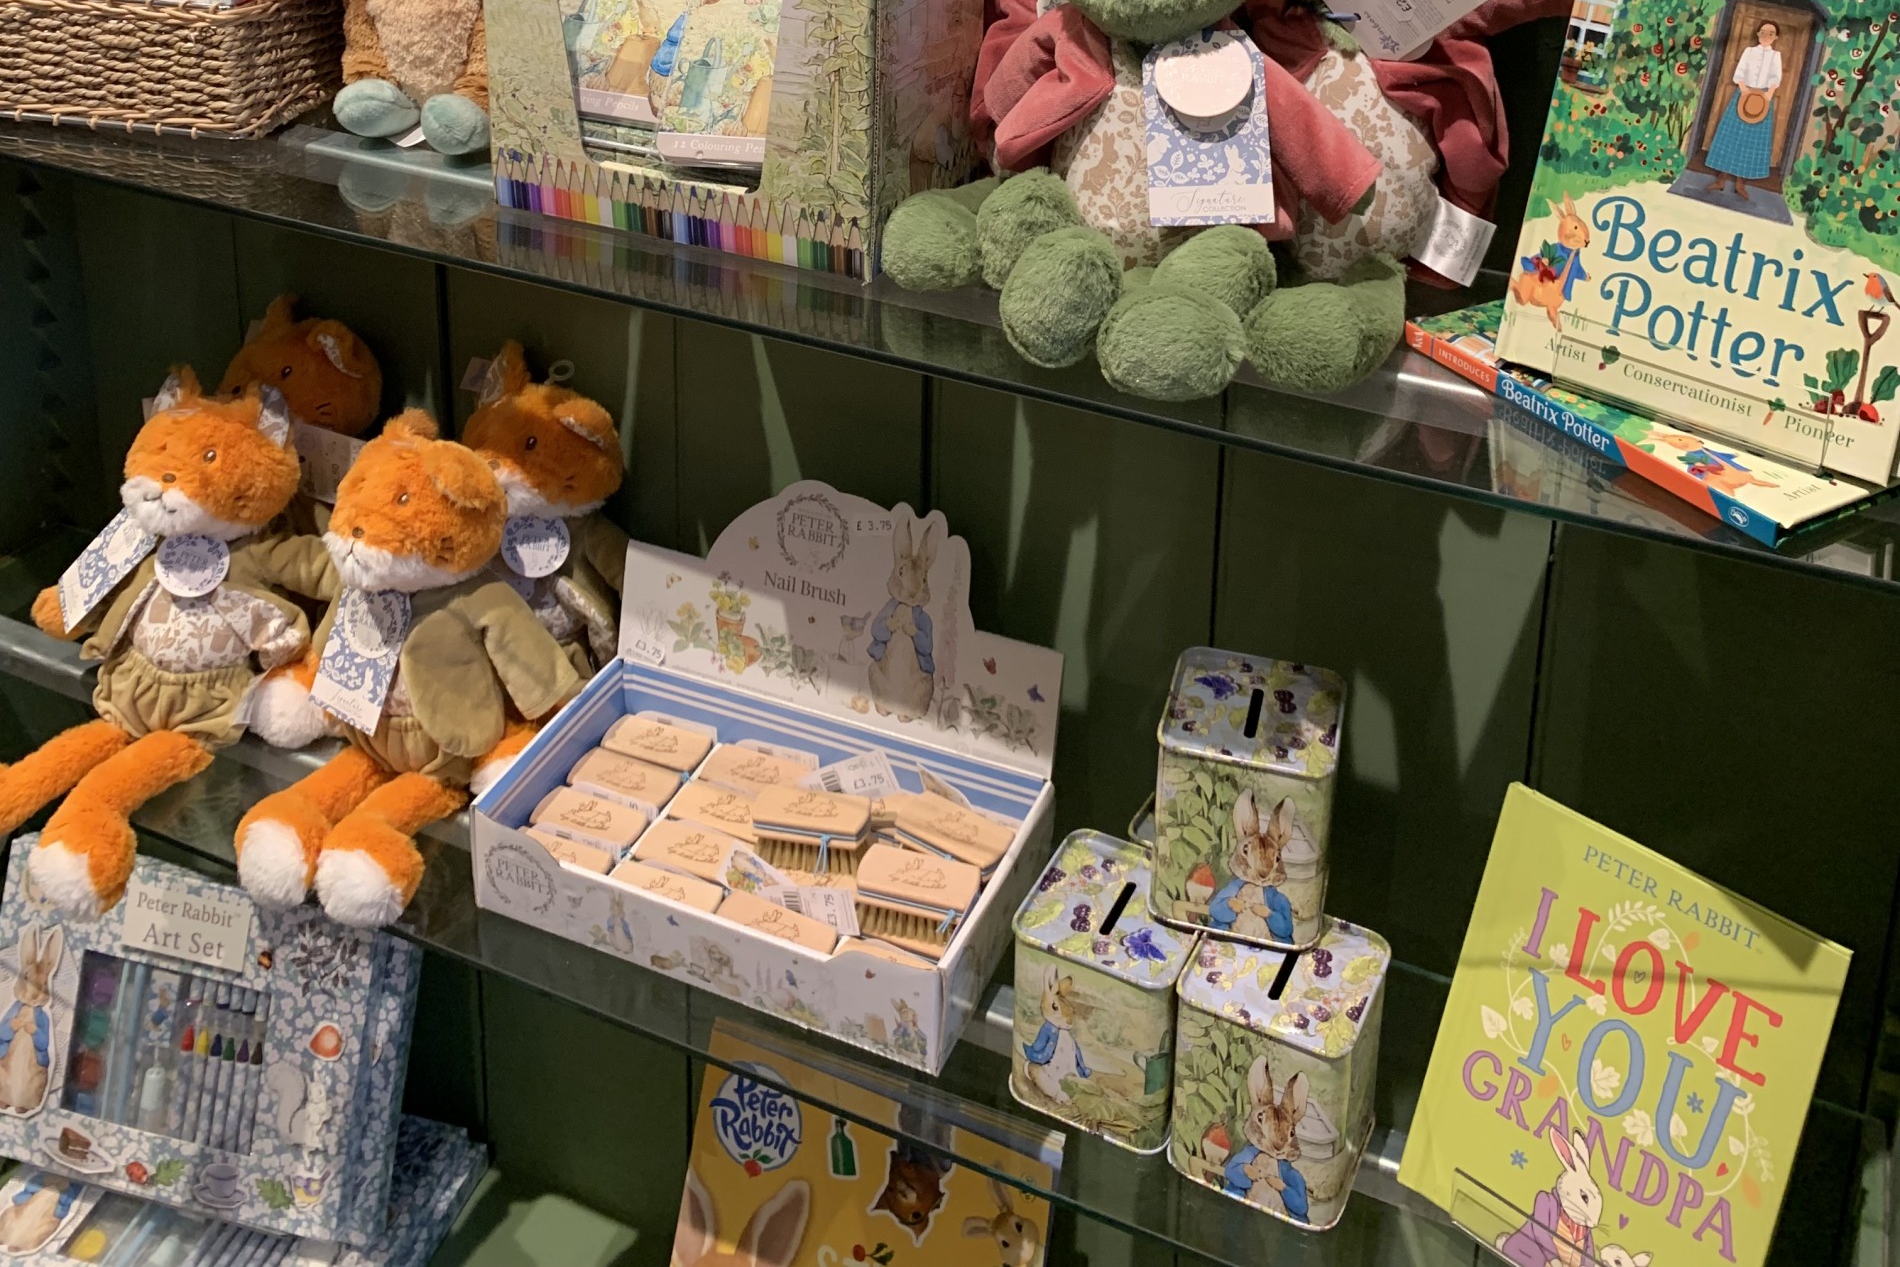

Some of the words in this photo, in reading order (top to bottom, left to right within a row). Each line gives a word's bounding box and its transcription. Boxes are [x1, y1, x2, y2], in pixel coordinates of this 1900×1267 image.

[604, 97, 640, 112] Pencils
[673, 140, 686, 149] 12
[690, 140, 741, 155] Colouring
[1592, 196, 1854, 326] Beatrix
[1600, 272, 1805, 387] Potter
[1438, 347, 1490, 383] INTRODUCES
[1501, 379, 1559, 425] Beatrix
[1561, 411, 1609, 452] Potter
[1544, 337, 1586, 363] Artist
[1623, 364, 1753, 418] Conservationist
[1784, 415, 1855, 448] Pioneer
[1783, 484, 1821, 501] Artist
[787, 524, 837, 547] RABBIT
[792, 513, 834, 534] PETER
[764, 570, 796, 593] Nail
[800, 580, 846, 606] Brush
[635, 639, 662, 660] £3.75
[853, 773, 885, 790] £3.75
[495, 868, 545, 893] RABBIT
[497, 858, 538, 880] PETER
[137, 892, 178, 915] Peter
[181, 902, 233, 928] Rabbit
[823, 893, 838, 927] £3.75
[1583, 844, 1658, 898] PETER
[1666, 889, 1761, 950] RABBIT
[142, 923, 181, 950] Art
[189, 932, 225, 960] Set
[1521, 887, 1559, 958] I
[1565, 907, 1783, 1086] LOVE
[1517, 967, 1747, 1169] YOU
[733, 1064, 793, 1120] Peter
[709, 1097, 802, 1158] Rabbit
[1462, 1050, 1737, 1263] GRANDPA
